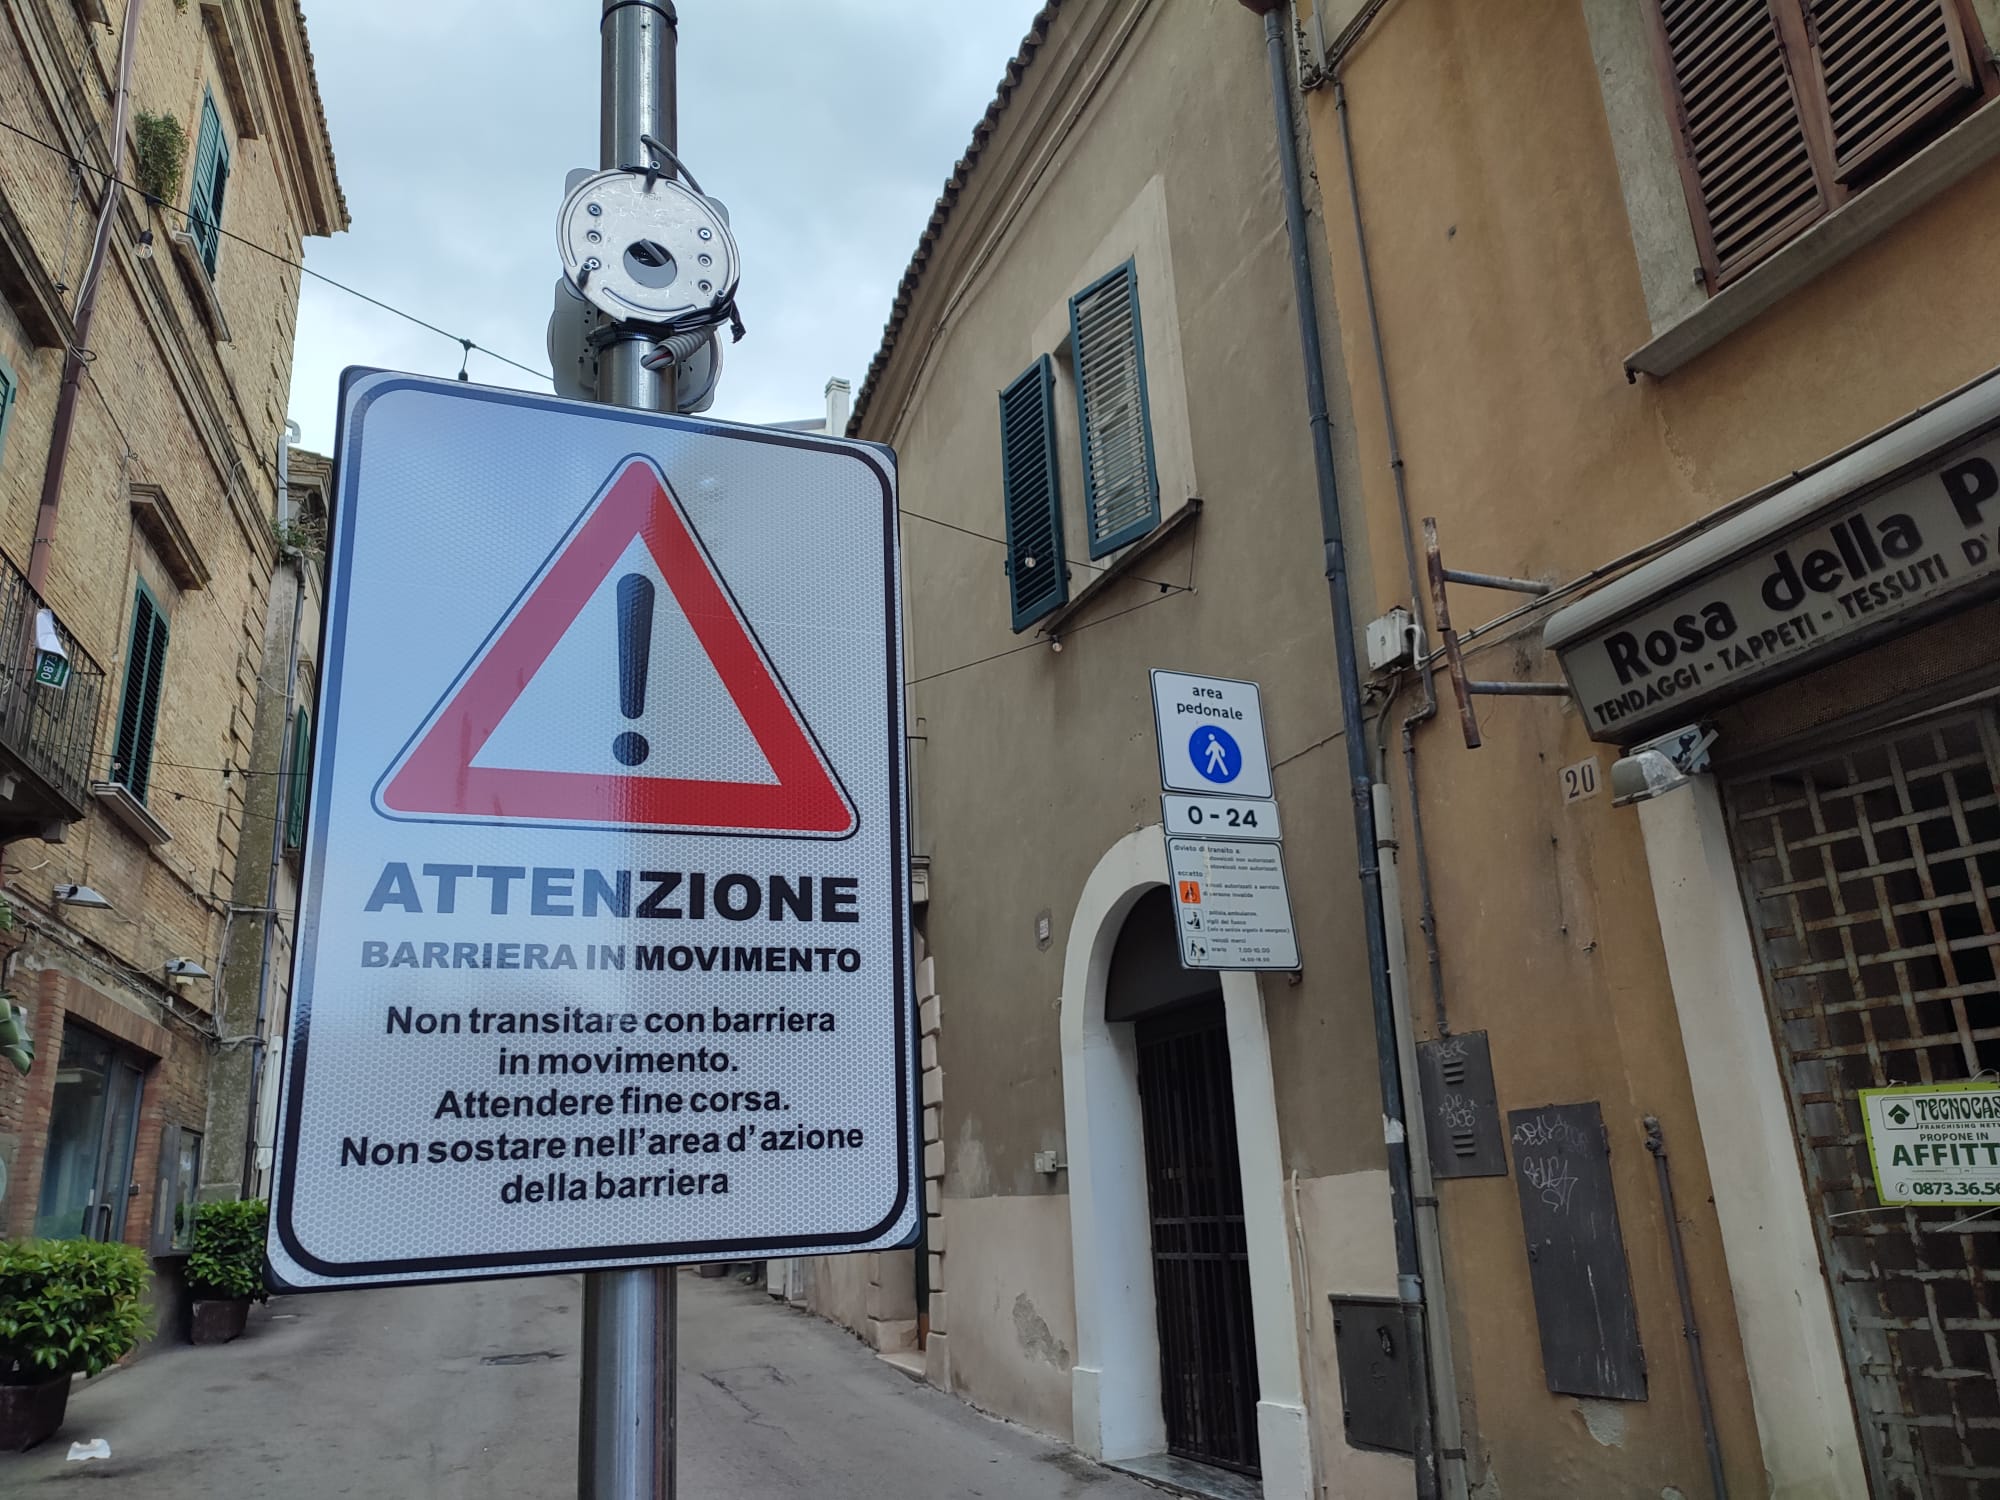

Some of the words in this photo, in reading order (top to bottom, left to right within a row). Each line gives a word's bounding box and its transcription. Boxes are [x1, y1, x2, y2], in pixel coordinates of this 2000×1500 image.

[1604, 601, 1738, 686] Rosa
[1761, 513, 1924, 612] della
[1940, 457, 1999, 530] P
[1593, 663, 1702, 726] TENDAGGI
[1717, 612, 1818, 671] TAPPETI
[1838, 553, 1950, 619] TESSUTI
[1192, 686, 1223, 700] area
[1176, 702, 1244, 721] pedonale
[1565, 764, 1595, 799] 20
[1207, 846, 1234, 854] transito
[363, 862, 859, 922] ATTENZIONE
[361, 941, 577, 970] BARRIERA
[586, 944, 626, 971] IN
[635, 945, 861, 973] MOVIMENTO
[386, 1006, 461, 1034] Non
[469, 1007, 638, 1034] transitare
[644, 1013, 705, 1033] con
[713, 1007, 836, 1033] barriera
[499, 1047, 530, 1075] in
[538, 1047, 738, 1074] movimento.
[434, 1088, 615, 1119] Attendere
[621, 1087, 684, 1114] fine
[690, 1090, 790, 1113] corsa.
[341, 1136, 420, 1167] Non
[427, 1132, 567, 1163] sostare
[1919, 1132, 1974, 1142] PROPONE
[1976, 1132, 1989, 1140] IN
[1892, 1143, 2000, 1167] AFFITT
[501, 1172, 588, 1204] della
[595, 1168, 730, 1199] barriera
